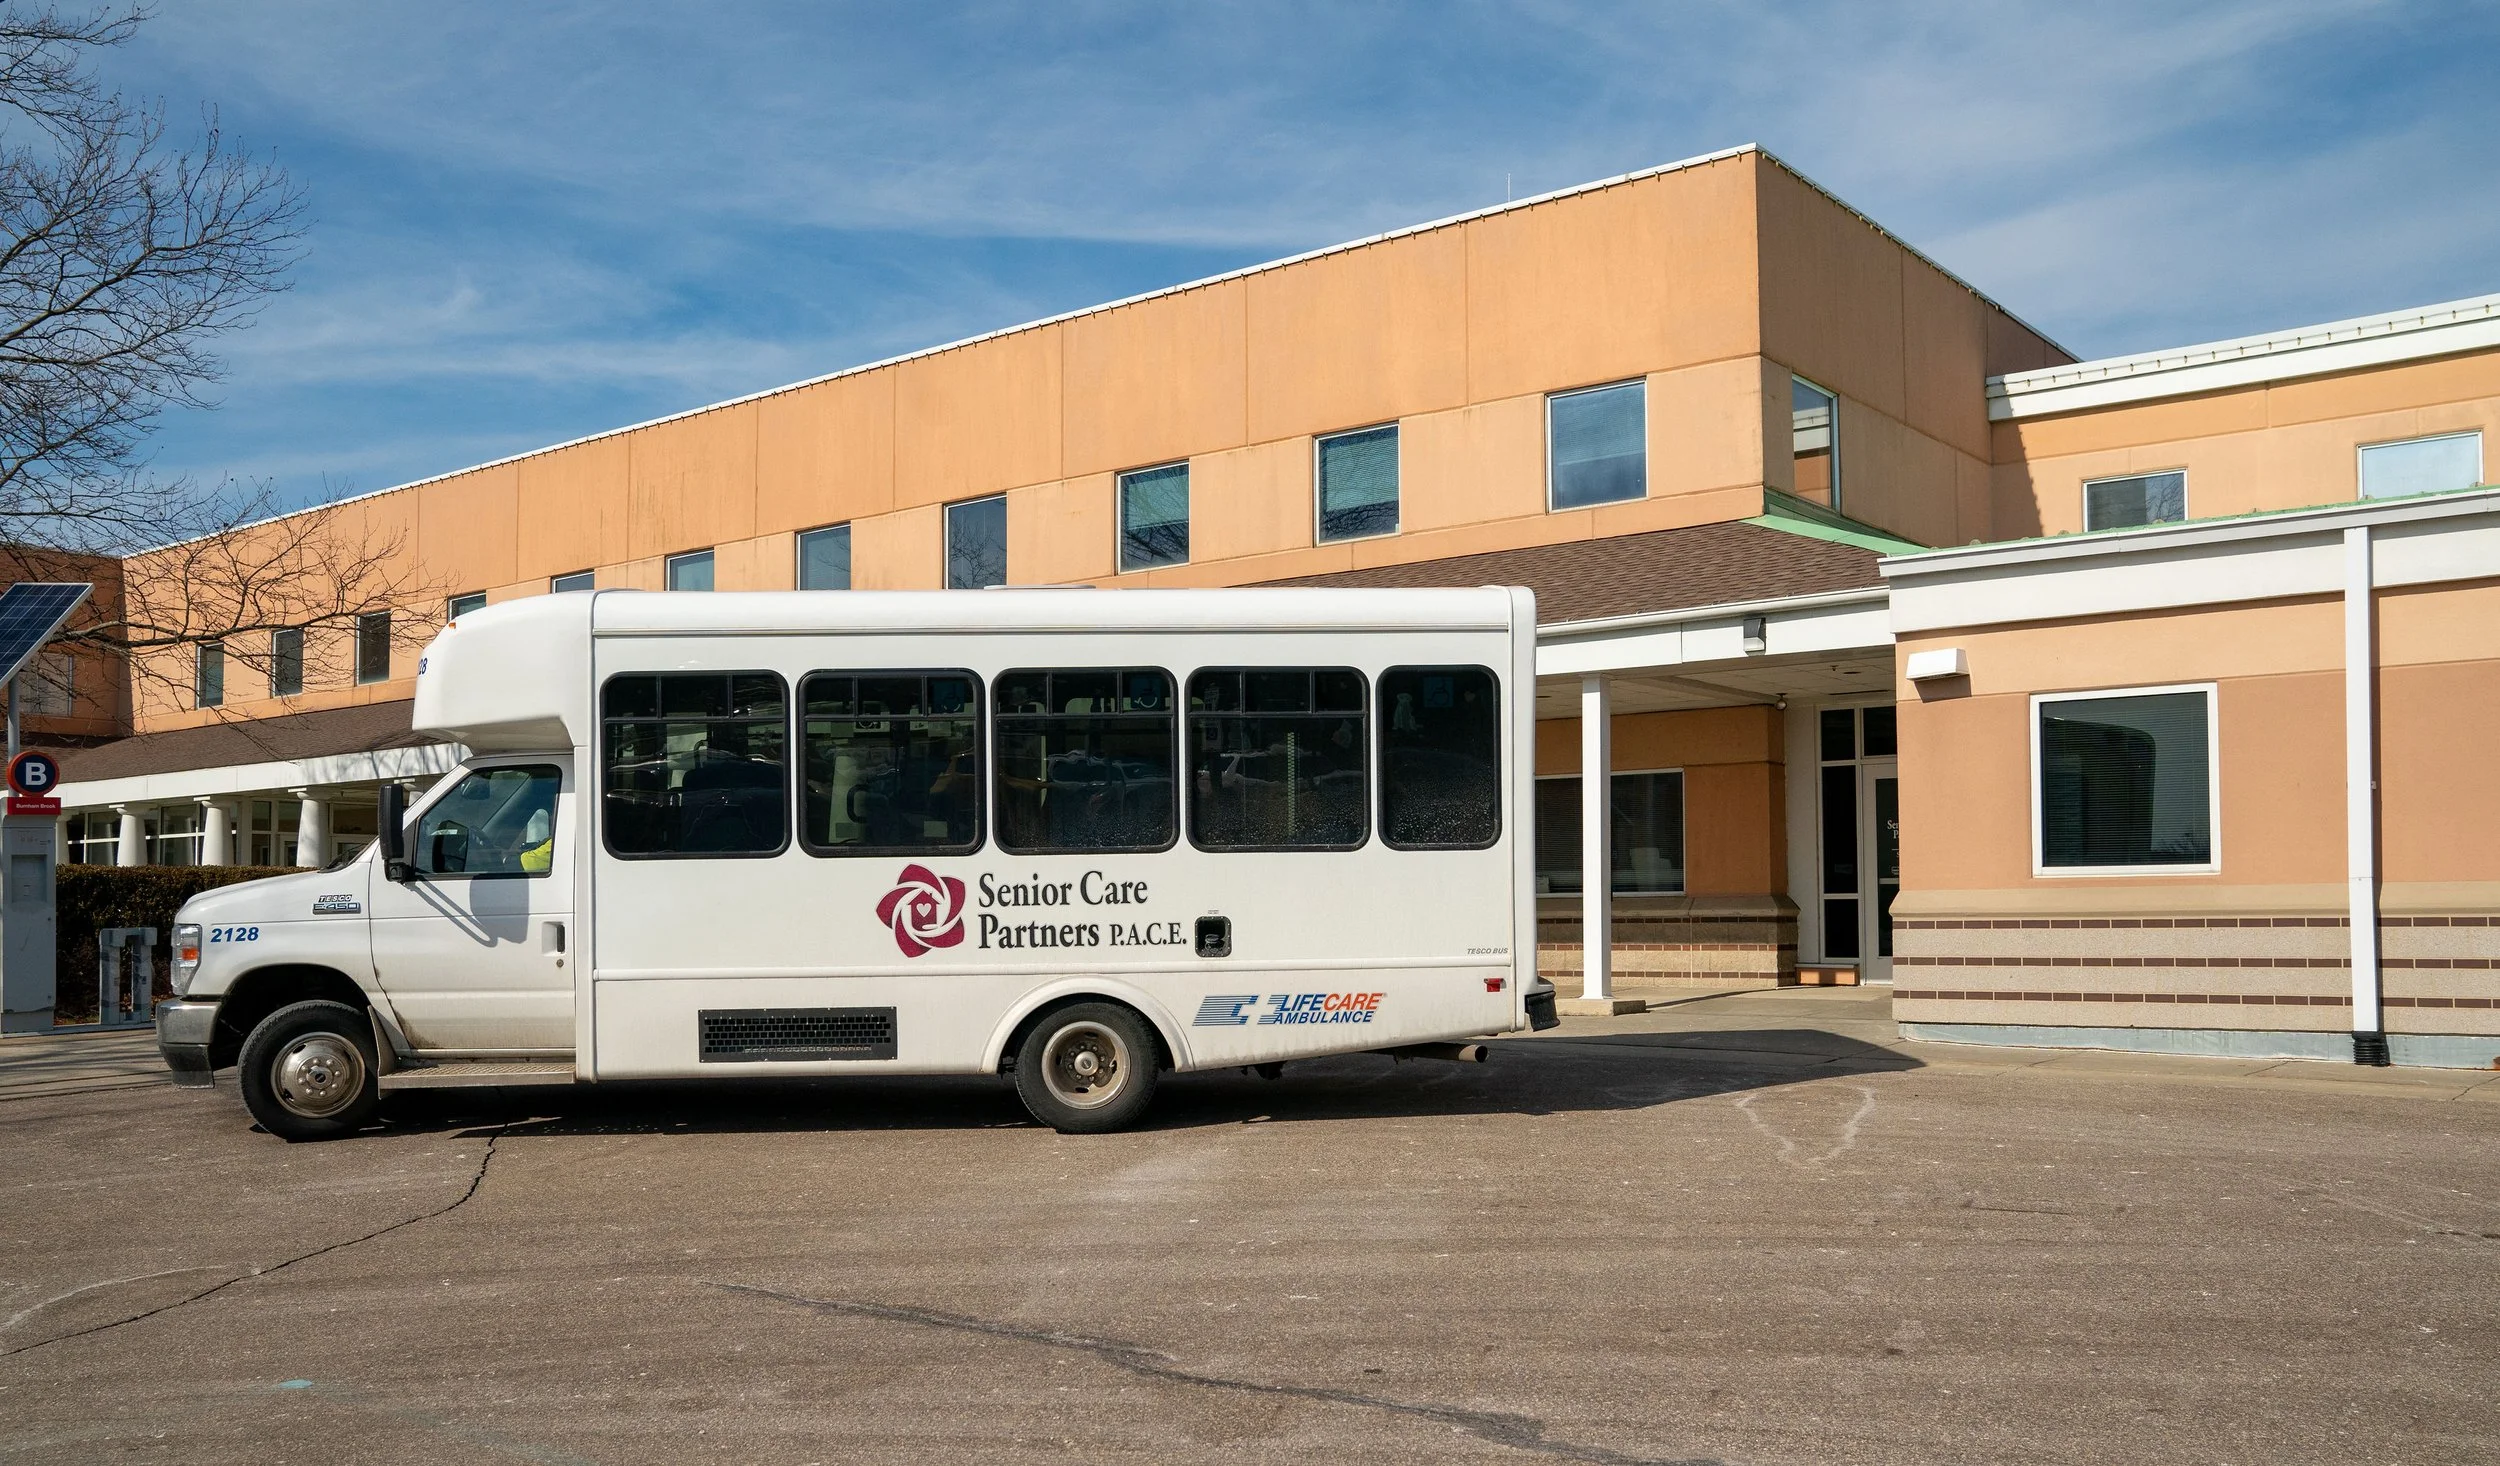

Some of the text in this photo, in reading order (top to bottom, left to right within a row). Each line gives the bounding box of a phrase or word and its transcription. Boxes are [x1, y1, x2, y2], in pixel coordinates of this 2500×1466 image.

[25, 762, 47, 786] B
[978, 870, 1148, 907] Senior Care
[318, 894, 352, 902] TESCO
[210, 927, 259, 943] 2128
[978, 913, 1187, 949] Partners P.A.C.E.
[1467, 947, 1491, 955] TESCO
[1273, 1010, 1375, 1024] AMBULANCE
